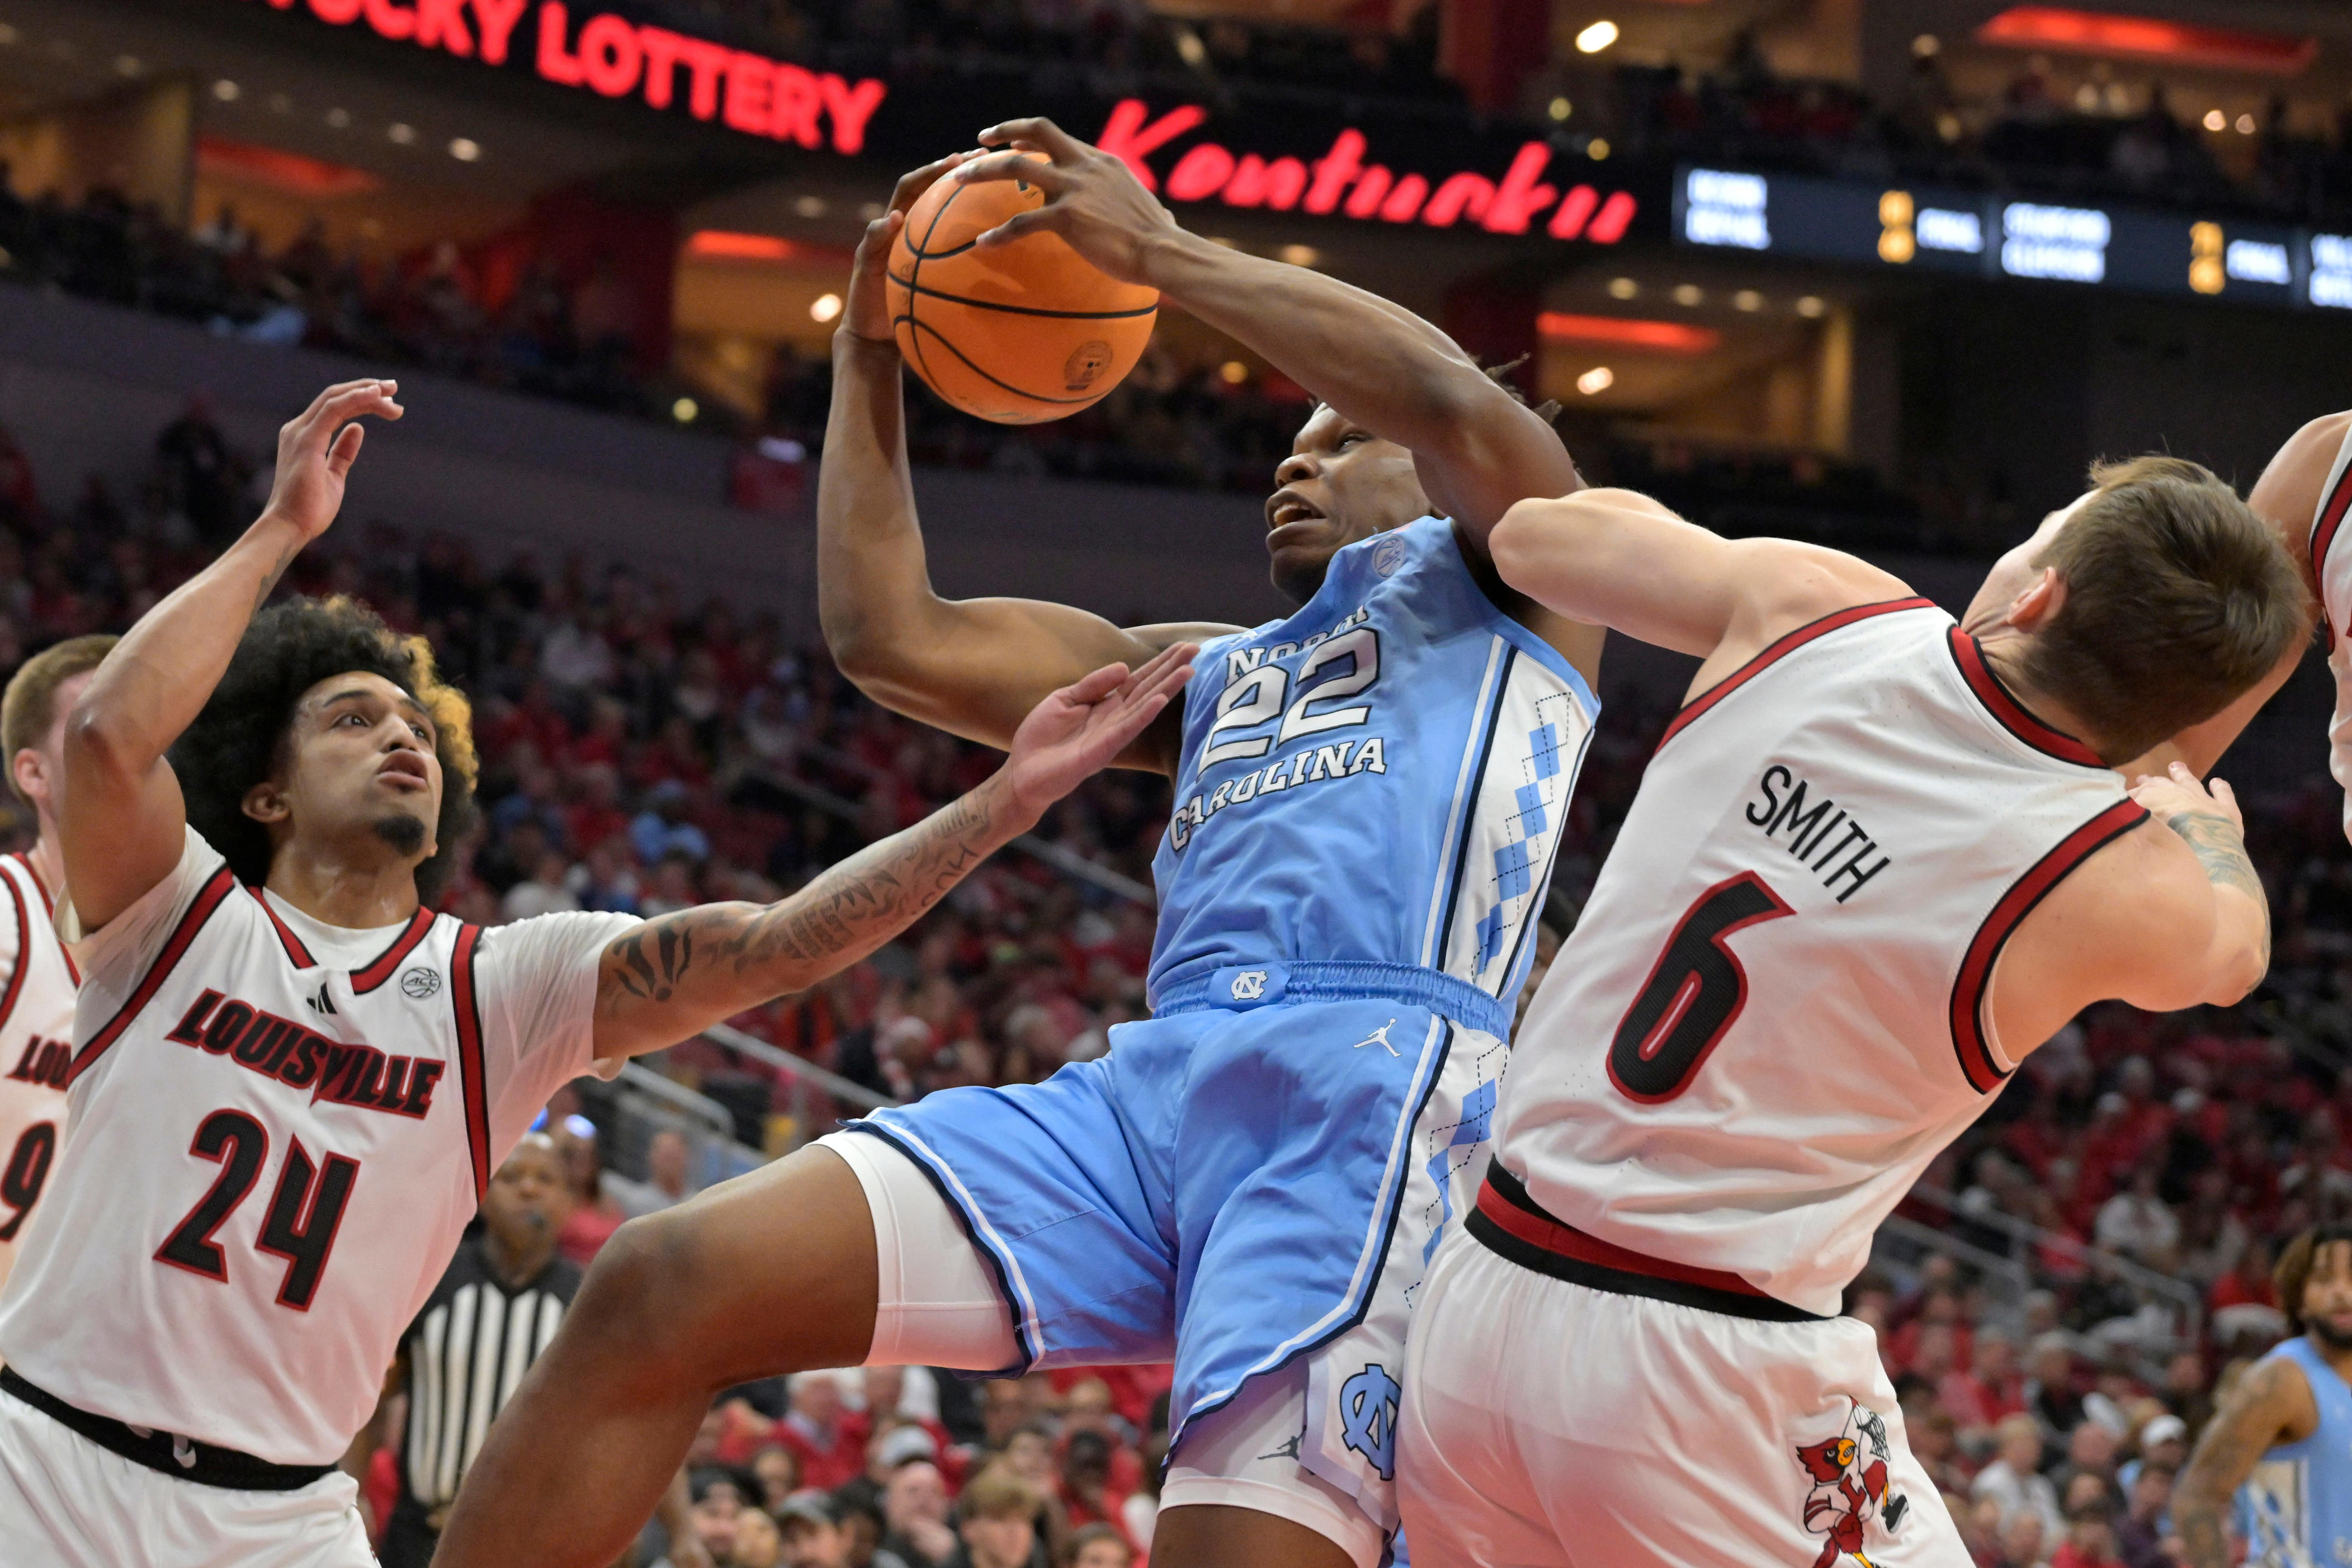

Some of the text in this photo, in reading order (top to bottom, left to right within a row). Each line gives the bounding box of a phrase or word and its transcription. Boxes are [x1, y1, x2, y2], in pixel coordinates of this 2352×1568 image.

[535, 0, 888, 156] LOTTERY
[1196, 626, 1380, 784] 22
[1169, 738, 1387, 852] CAROLINA
[1746, 765, 1891, 904] SMITH
[163, 988, 446, 1120] LOUISVILLE
[1605, 870, 1797, 1105] 6
[0, 1120, 56, 1243] 9
[153, 1107, 361, 1312] 24
